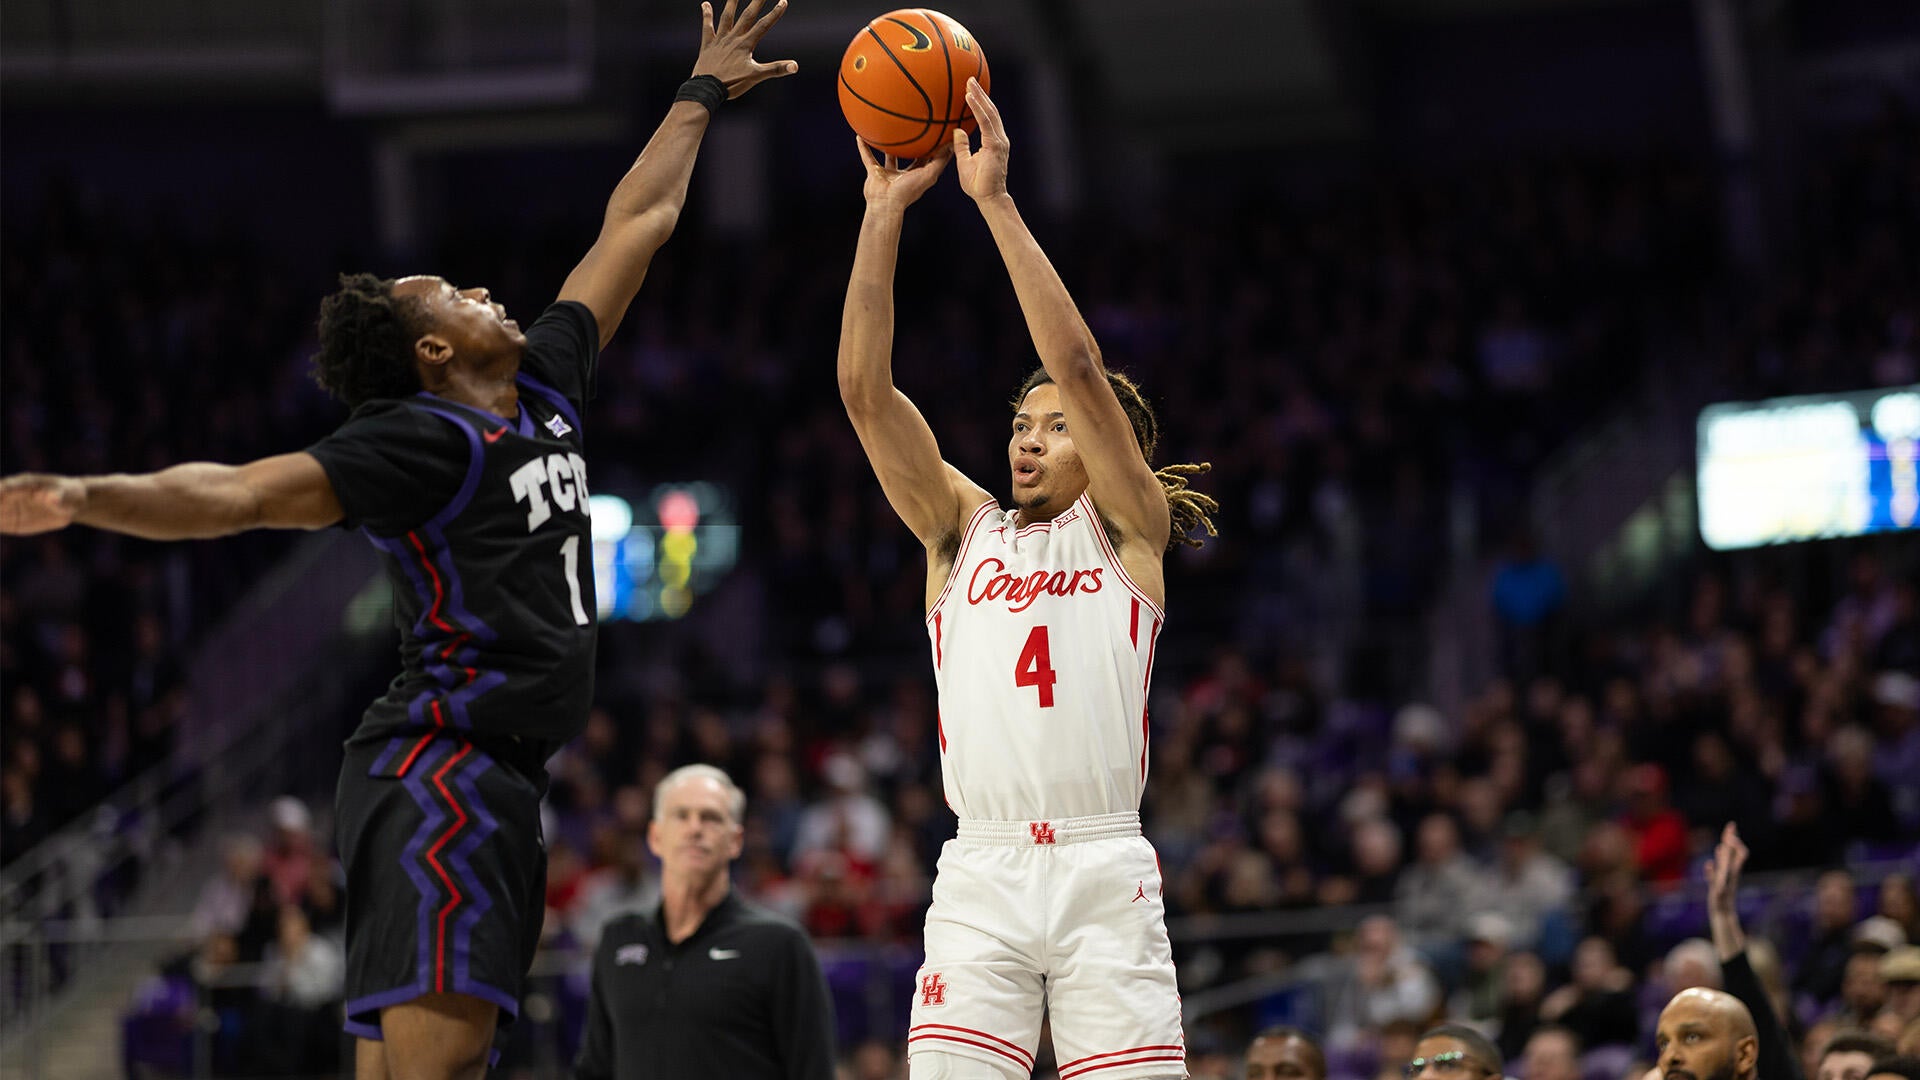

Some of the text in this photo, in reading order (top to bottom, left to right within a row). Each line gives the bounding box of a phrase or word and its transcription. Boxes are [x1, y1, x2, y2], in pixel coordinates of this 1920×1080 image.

[560, 535, 589, 625] 1
[967, 558, 1104, 613] Cougars
[1015, 626, 1056, 708] 4
